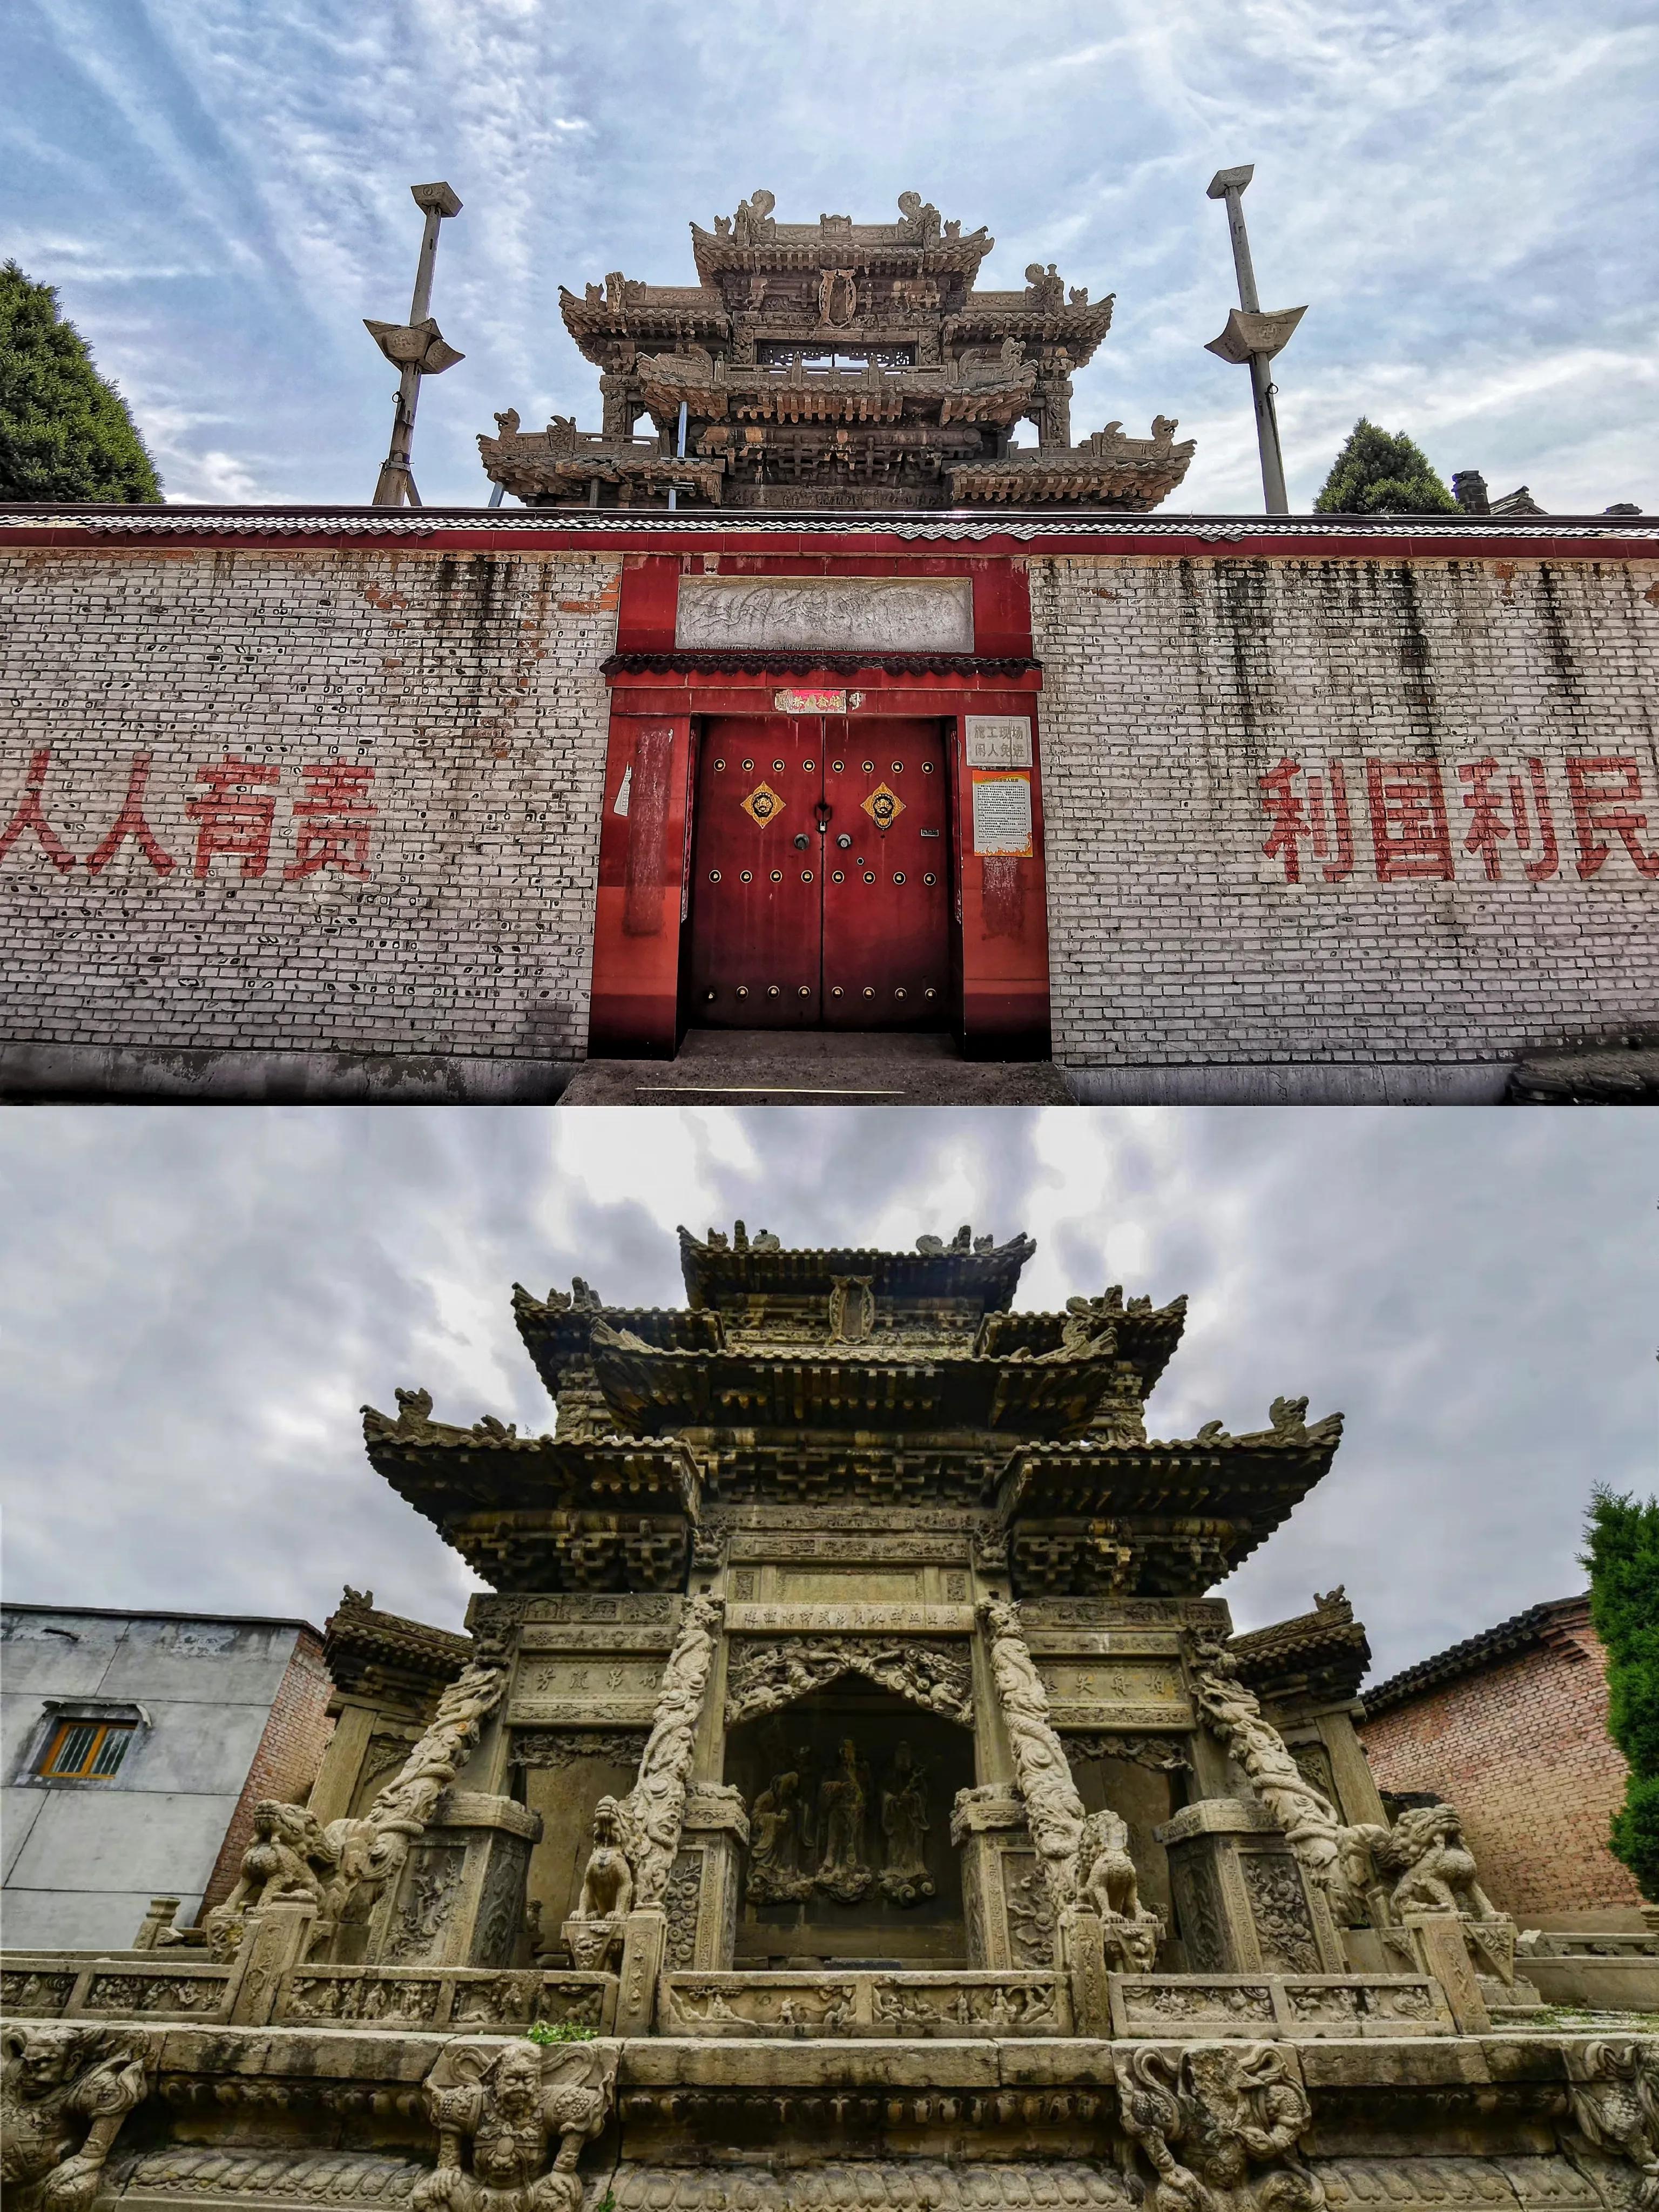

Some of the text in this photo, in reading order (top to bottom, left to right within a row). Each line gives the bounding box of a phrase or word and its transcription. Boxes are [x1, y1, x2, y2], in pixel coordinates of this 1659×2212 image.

[974, 725, 1023, 739] 施工现场
[975, 743, 1024, 757] 闲人免进
[0, 750, 379, 882] 人人有责
[1258, 757, 1659, 884] 利国利民
